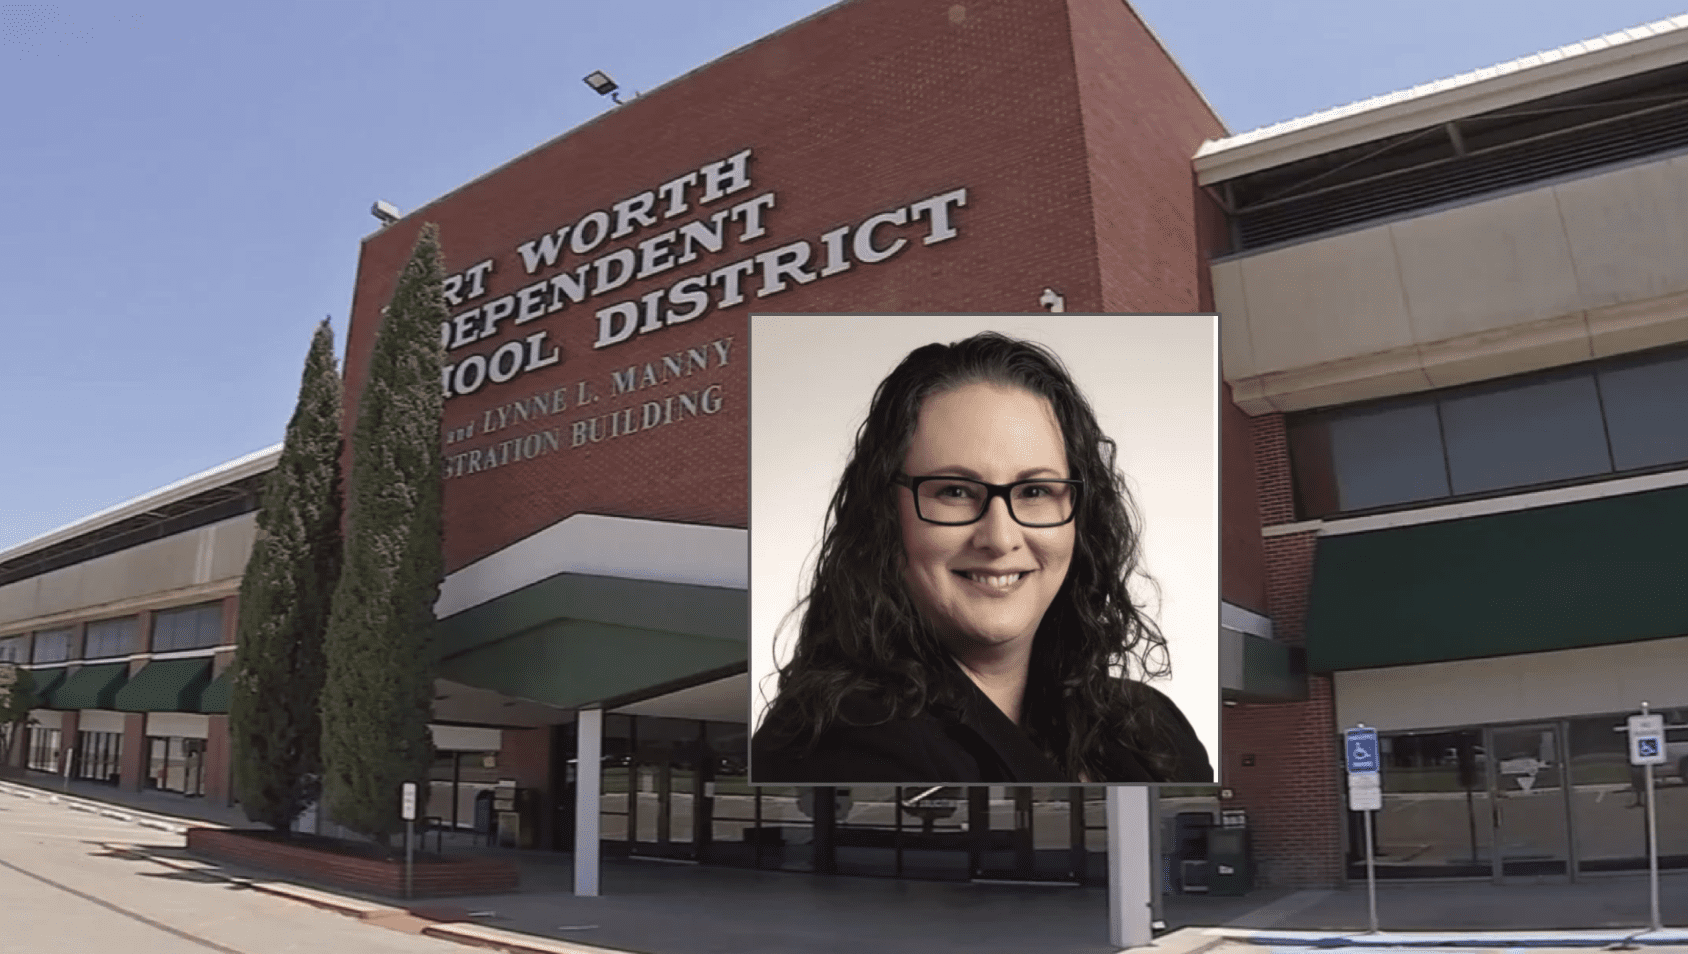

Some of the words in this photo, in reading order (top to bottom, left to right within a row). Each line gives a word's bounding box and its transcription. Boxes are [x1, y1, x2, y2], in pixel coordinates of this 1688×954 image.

[516, 149, 752, 274] WORTH
[593, 188, 967, 349] DISTRICT
[483, 387, 567, 434] LYNNE
[571, 381, 600, 407] L.
[610, 336, 734, 398] MANNY
[571, 384, 723, 448] BUILDING
